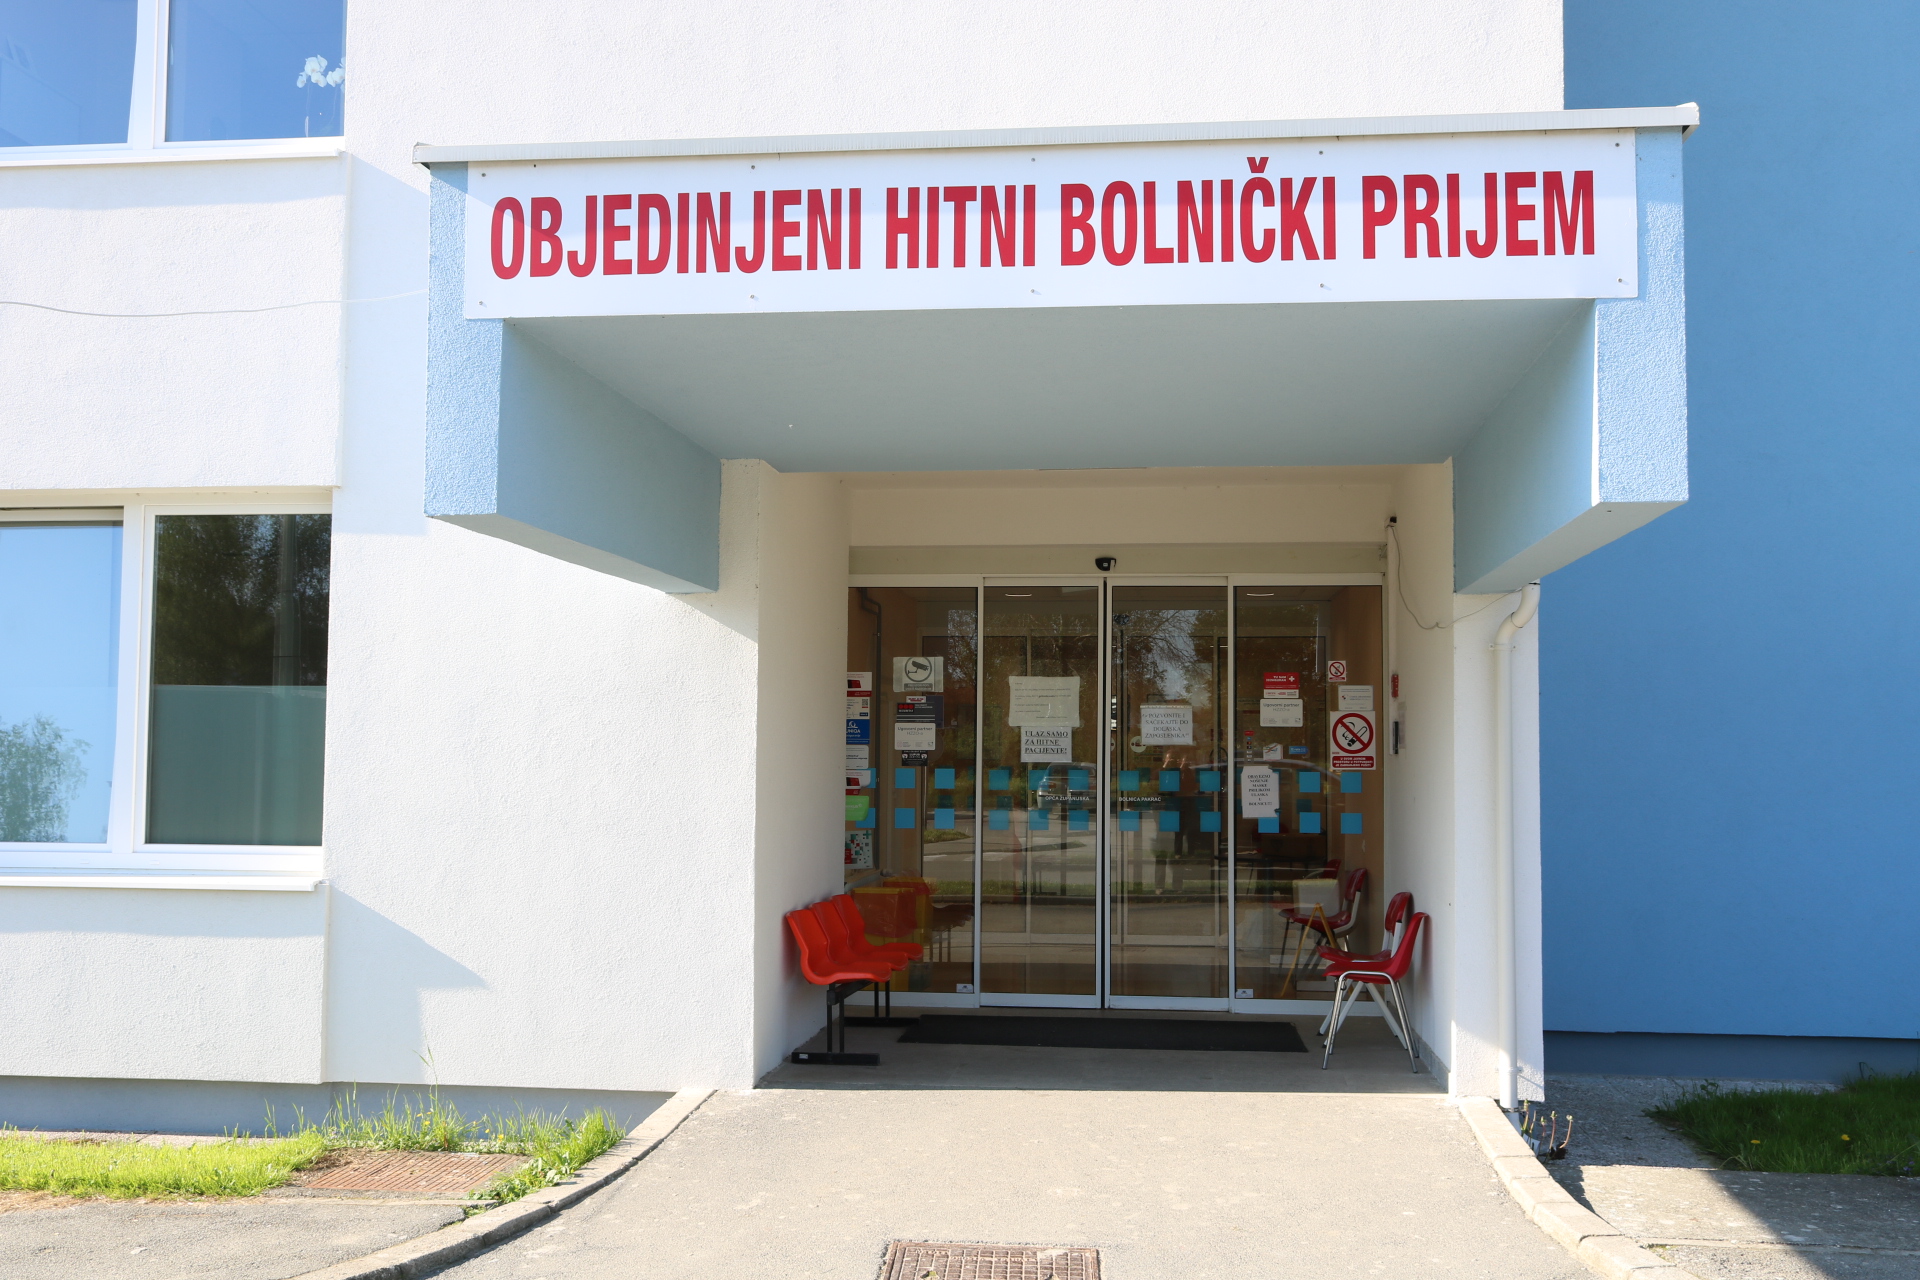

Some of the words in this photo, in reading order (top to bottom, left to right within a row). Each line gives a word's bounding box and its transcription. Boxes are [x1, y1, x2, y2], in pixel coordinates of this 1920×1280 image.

[490, 188, 861, 280] OBJEDINJENI
[886, 184, 1036, 270] HITNI
[1060, 156, 1337, 266] BOLNIČKI
[1362, 170, 1595, 259] PRIJEM
